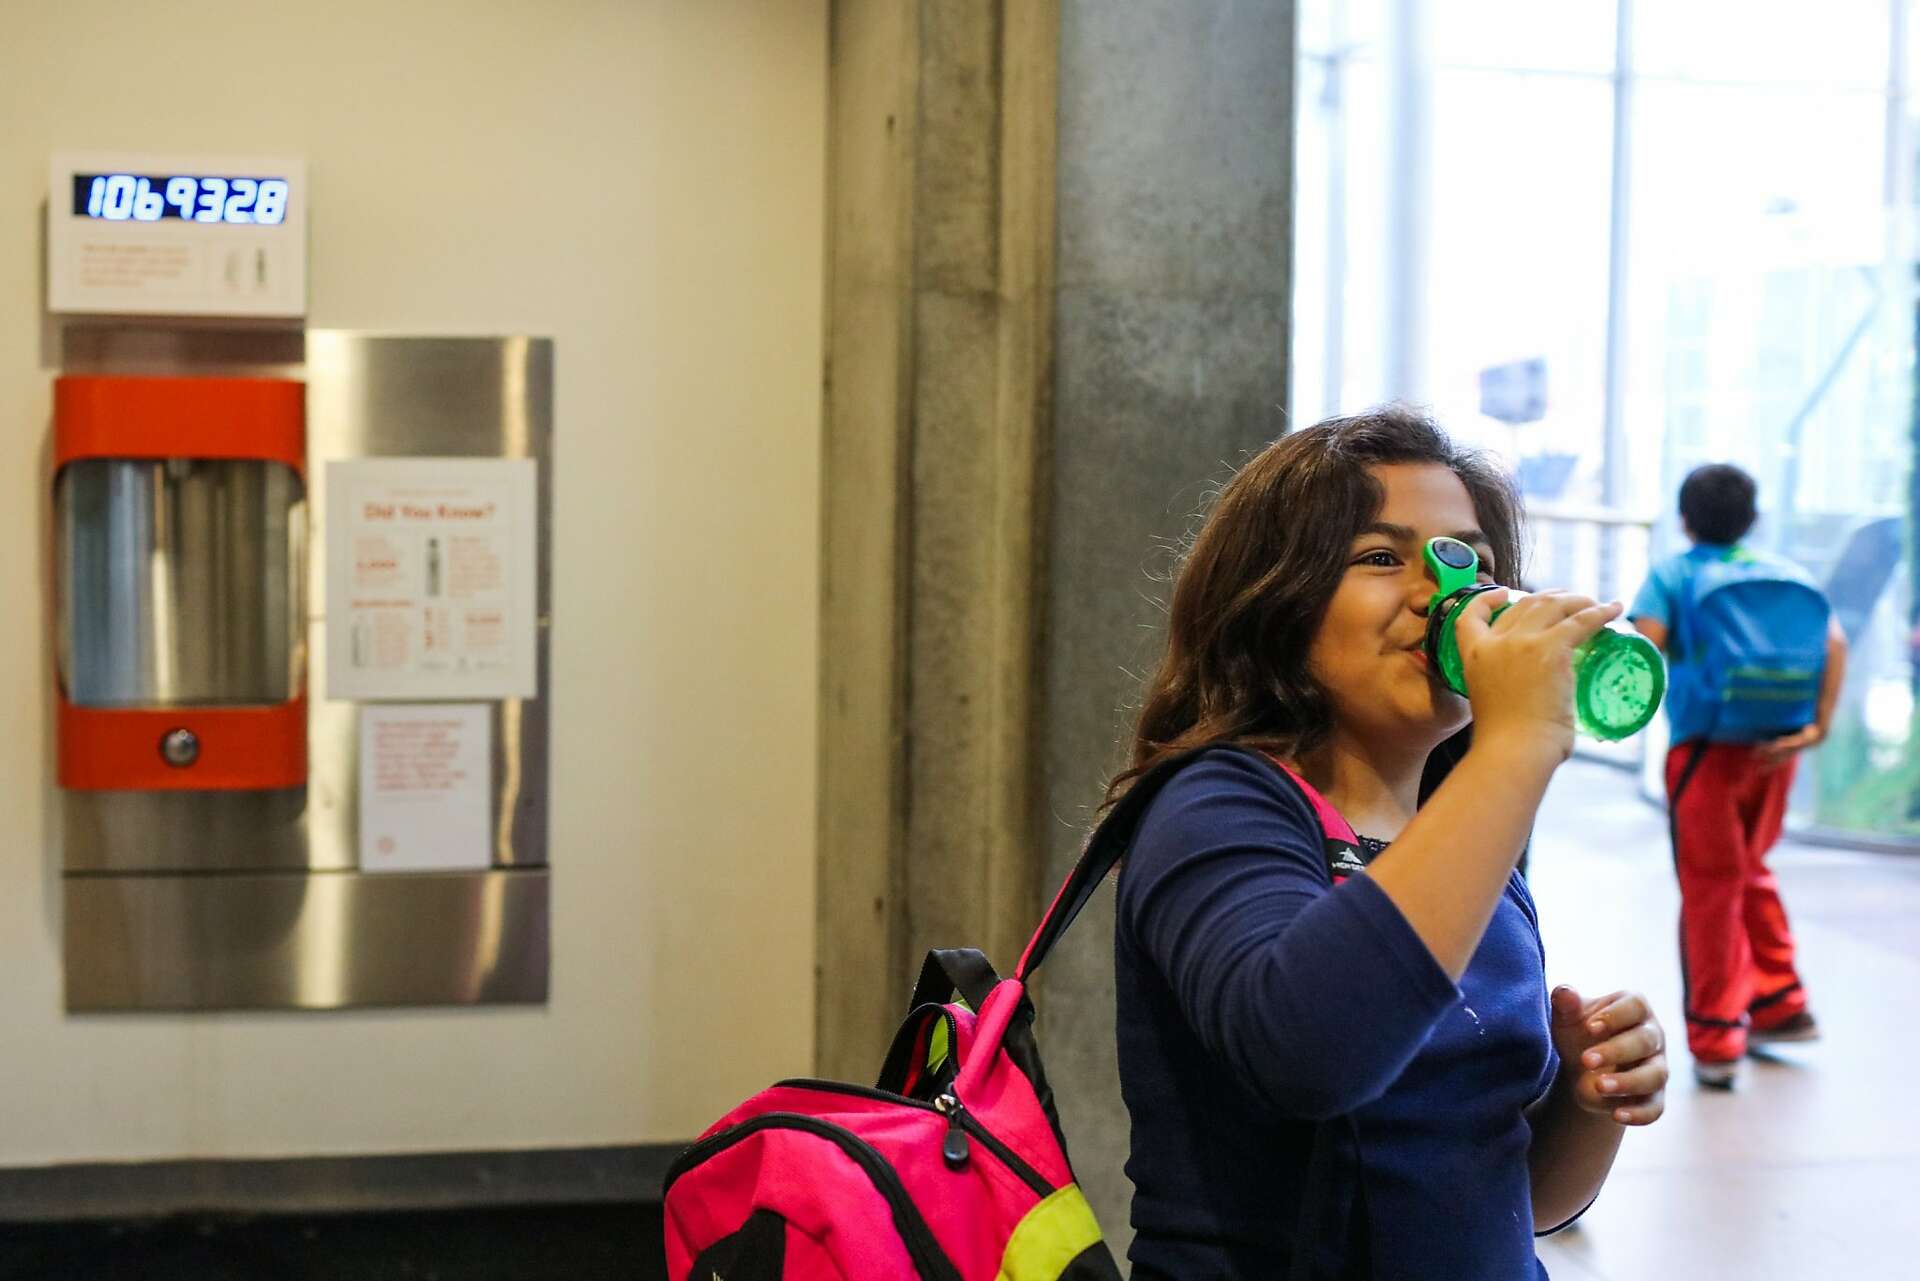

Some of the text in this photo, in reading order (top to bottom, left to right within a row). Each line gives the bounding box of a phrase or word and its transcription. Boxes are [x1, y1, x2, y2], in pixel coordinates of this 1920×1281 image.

[88, 175, 288, 224] 1069328
[364, 503, 496, 519] Did You Know?
